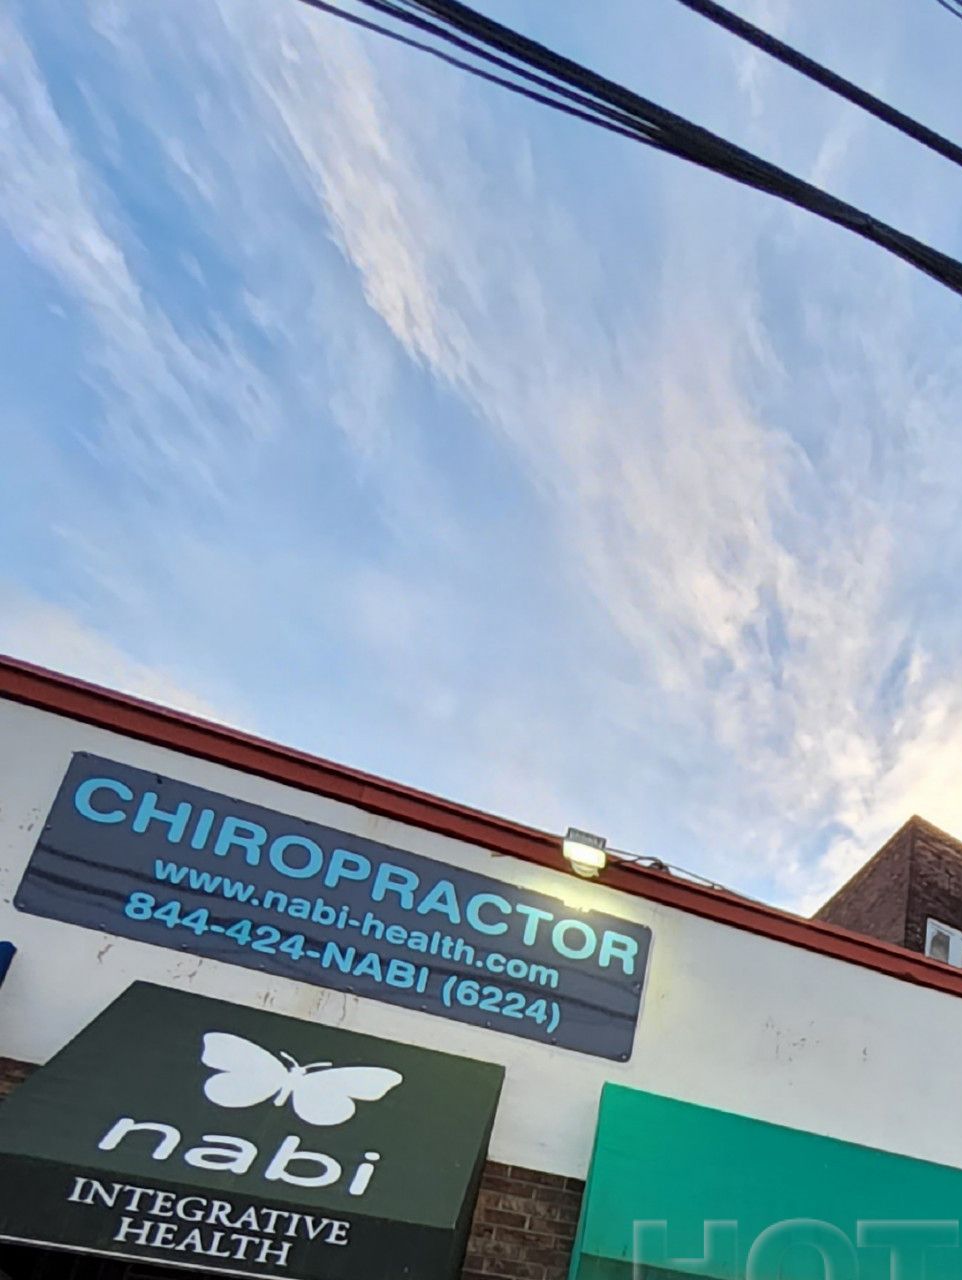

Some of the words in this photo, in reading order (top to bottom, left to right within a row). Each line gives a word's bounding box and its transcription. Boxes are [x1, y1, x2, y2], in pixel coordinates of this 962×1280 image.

[75, 776, 639, 975] CHIROPRACTOR
[155, 856, 559, 988] www.nabi-health.com
[125, 892, 428, 993] 844-424-NABI
[442, 976, 561, 1032] (6224)
[98, 1117, 380, 1196] nabi
[68, 1177, 350, 1246] INTEGRATIVE
[113, 1217, 292, 1266] HEALTH
